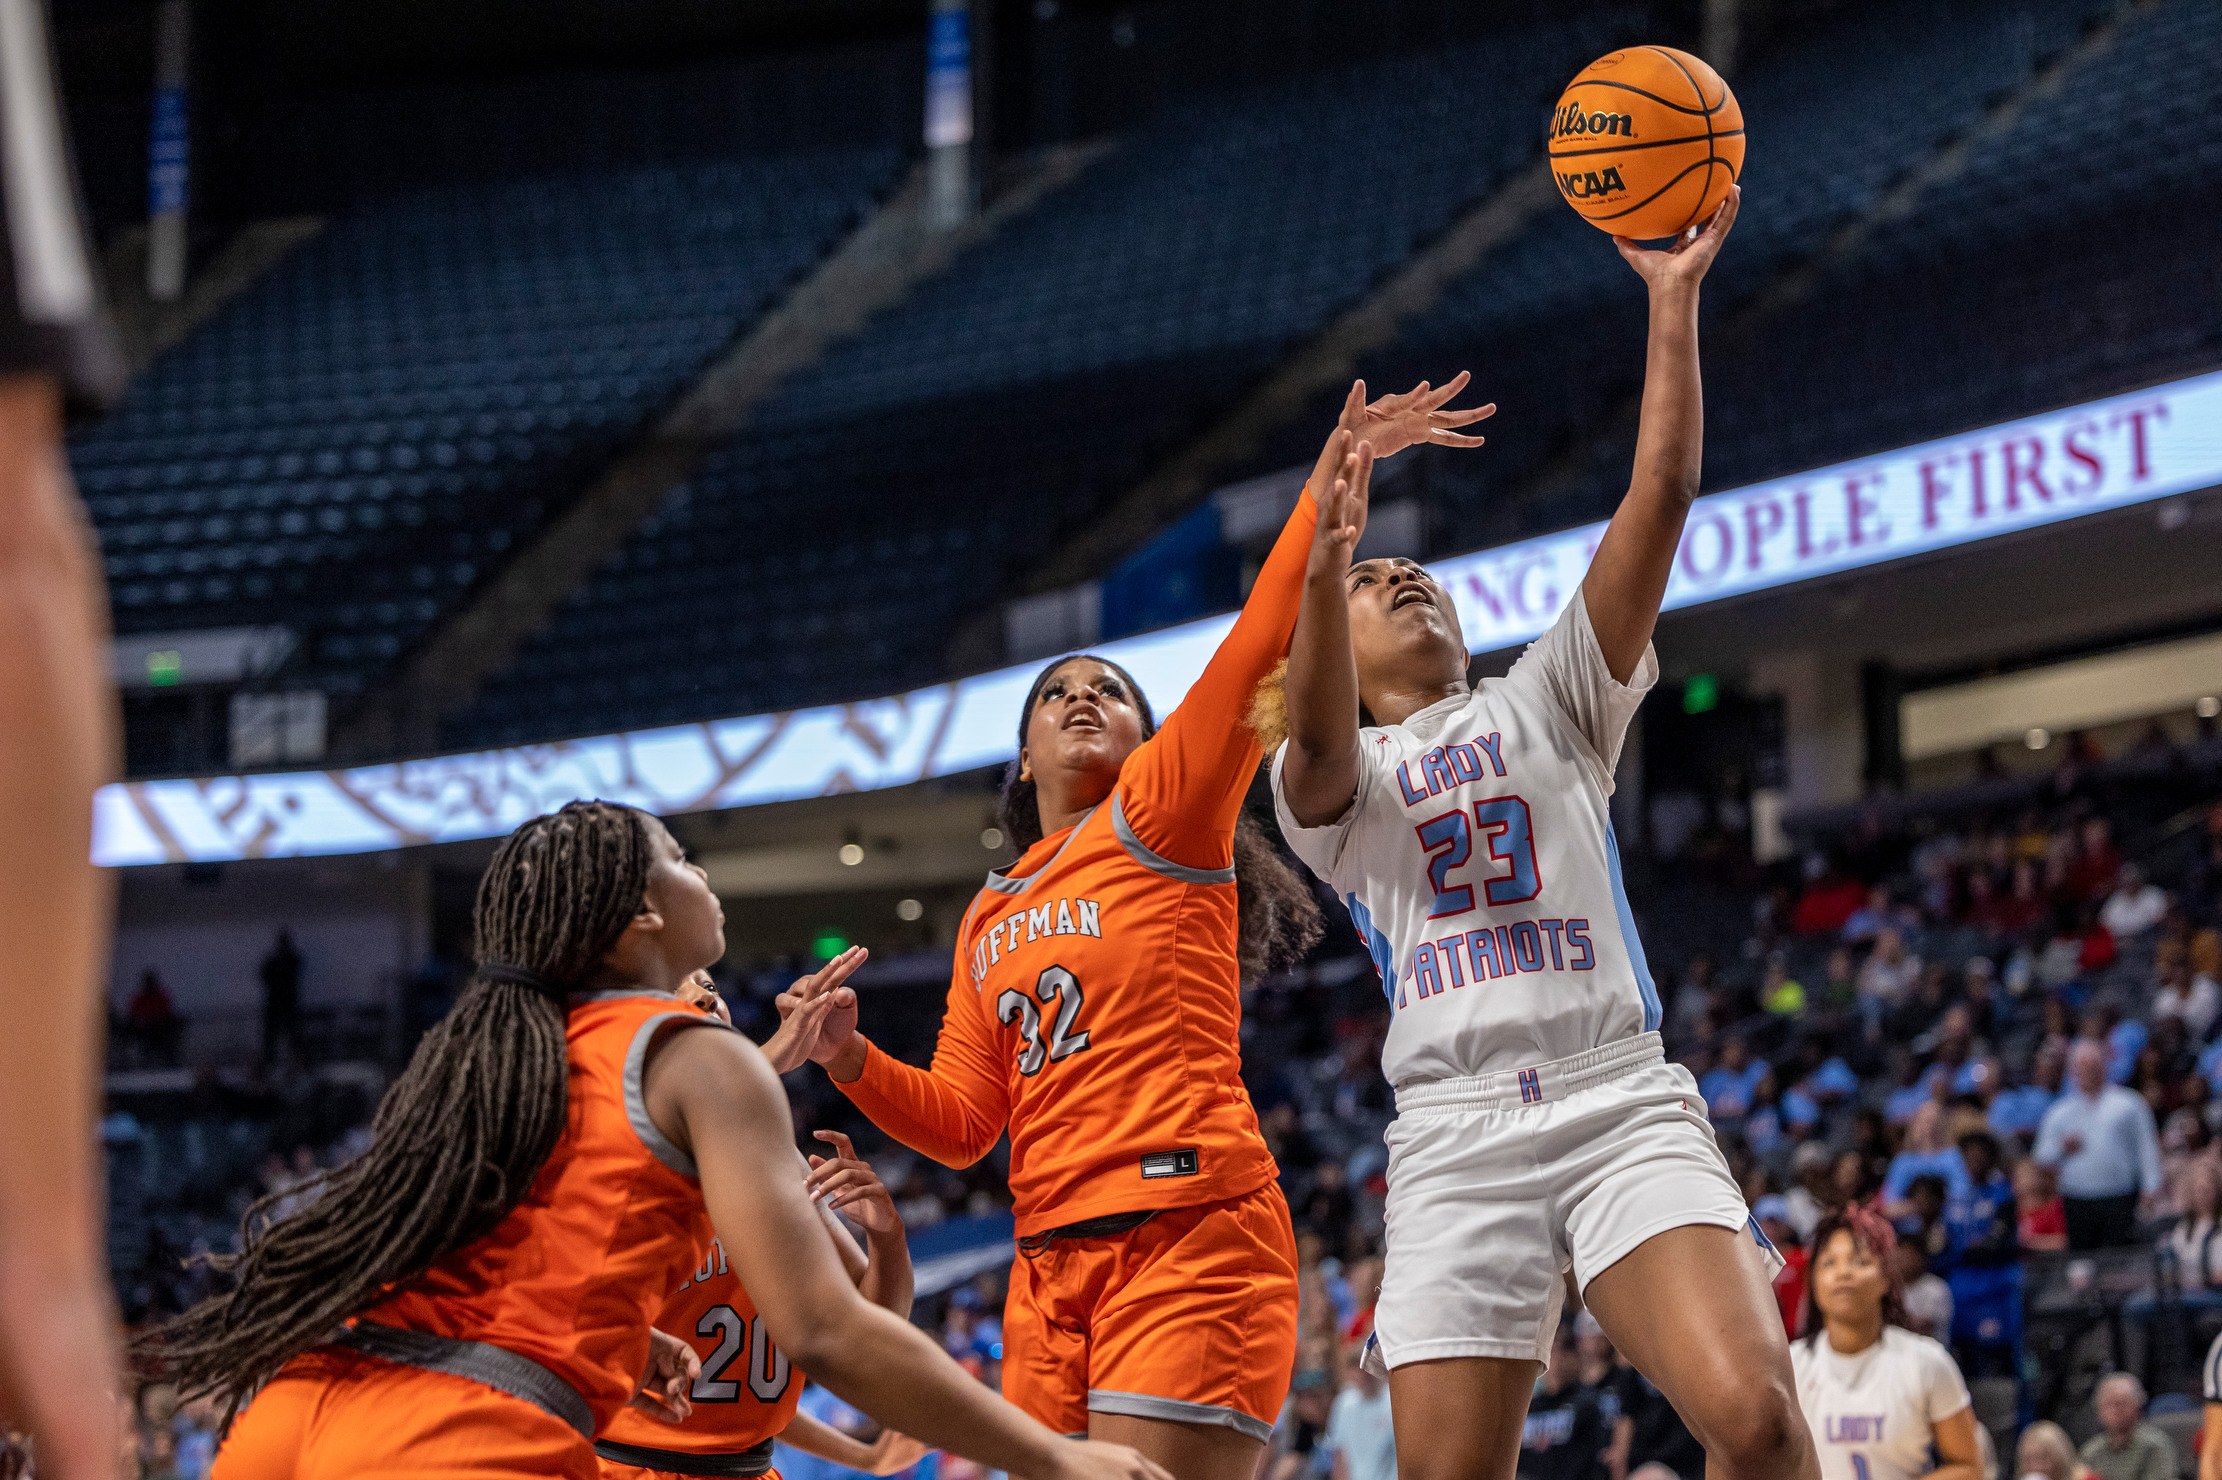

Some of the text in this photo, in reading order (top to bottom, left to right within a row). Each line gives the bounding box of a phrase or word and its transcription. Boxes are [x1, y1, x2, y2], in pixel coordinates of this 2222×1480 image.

[1555, 166, 1627, 198] NCAA
[1443, 402, 2173, 632] NG OPLE FIRST
[1396, 732, 1507, 807] LADY
[1415, 795, 1543, 920] 23
[997, 963, 1091, 1078] 32
[1518, 1068, 1542, 1104] H
[1181, 1157, 1190, 1168] L
[689, 1304, 792, 1404] 20
[1824, 1413, 1886, 1444] LADY
